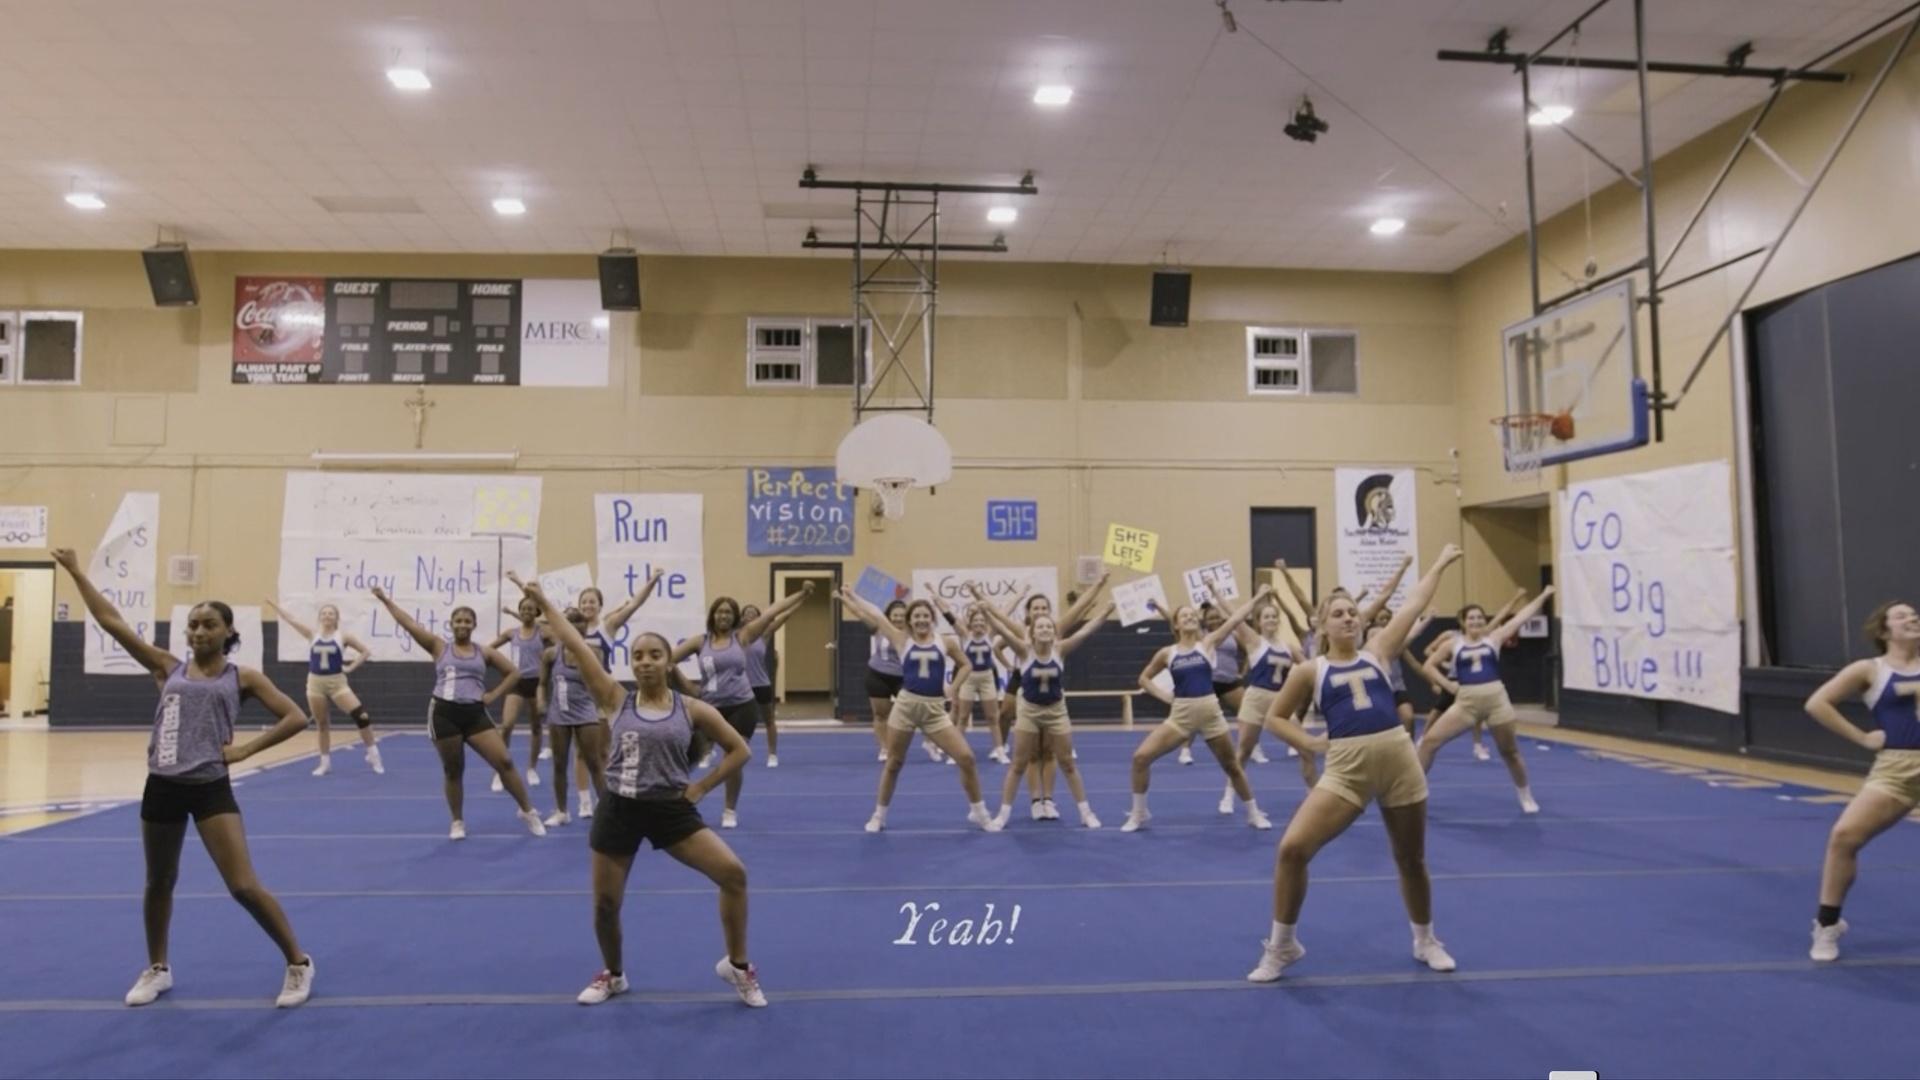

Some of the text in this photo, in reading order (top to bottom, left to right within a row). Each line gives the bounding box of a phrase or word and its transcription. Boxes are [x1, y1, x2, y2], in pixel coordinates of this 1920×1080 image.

[334, 282, 379, 295] GUEST
[471, 283, 512, 295] HOME
[387, 320, 428, 332] PERIOD
[753, 469, 847, 501] Perfect
[613, 499, 668, 543] Run
[750, 501, 843, 523] vision
[991, 504, 1036, 537] SHS
[1571, 490, 1622, 551] Go
[767, 523, 851, 546] #2020
[1114, 527, 1149, 548] SHS
[1112, 543, 1143, 562] LETS
[314, 556, 396, 600] Friday
[415, 555, 488, 606] Night
[624, 563, 687, 599] the
[1611, 562, 1666, 638] Big
[313, 645, 338, 670] T
[909, 651, 939, 679] T
[969, 645, 990, 665] T
[1459, 646, 1492, 673] T
[1593, 636, 1658, 693] Blue
[1031, 667, 1059, 694] T
[1267, 655, 1292, 684] T
[1329, 666, 1379, 711] T
